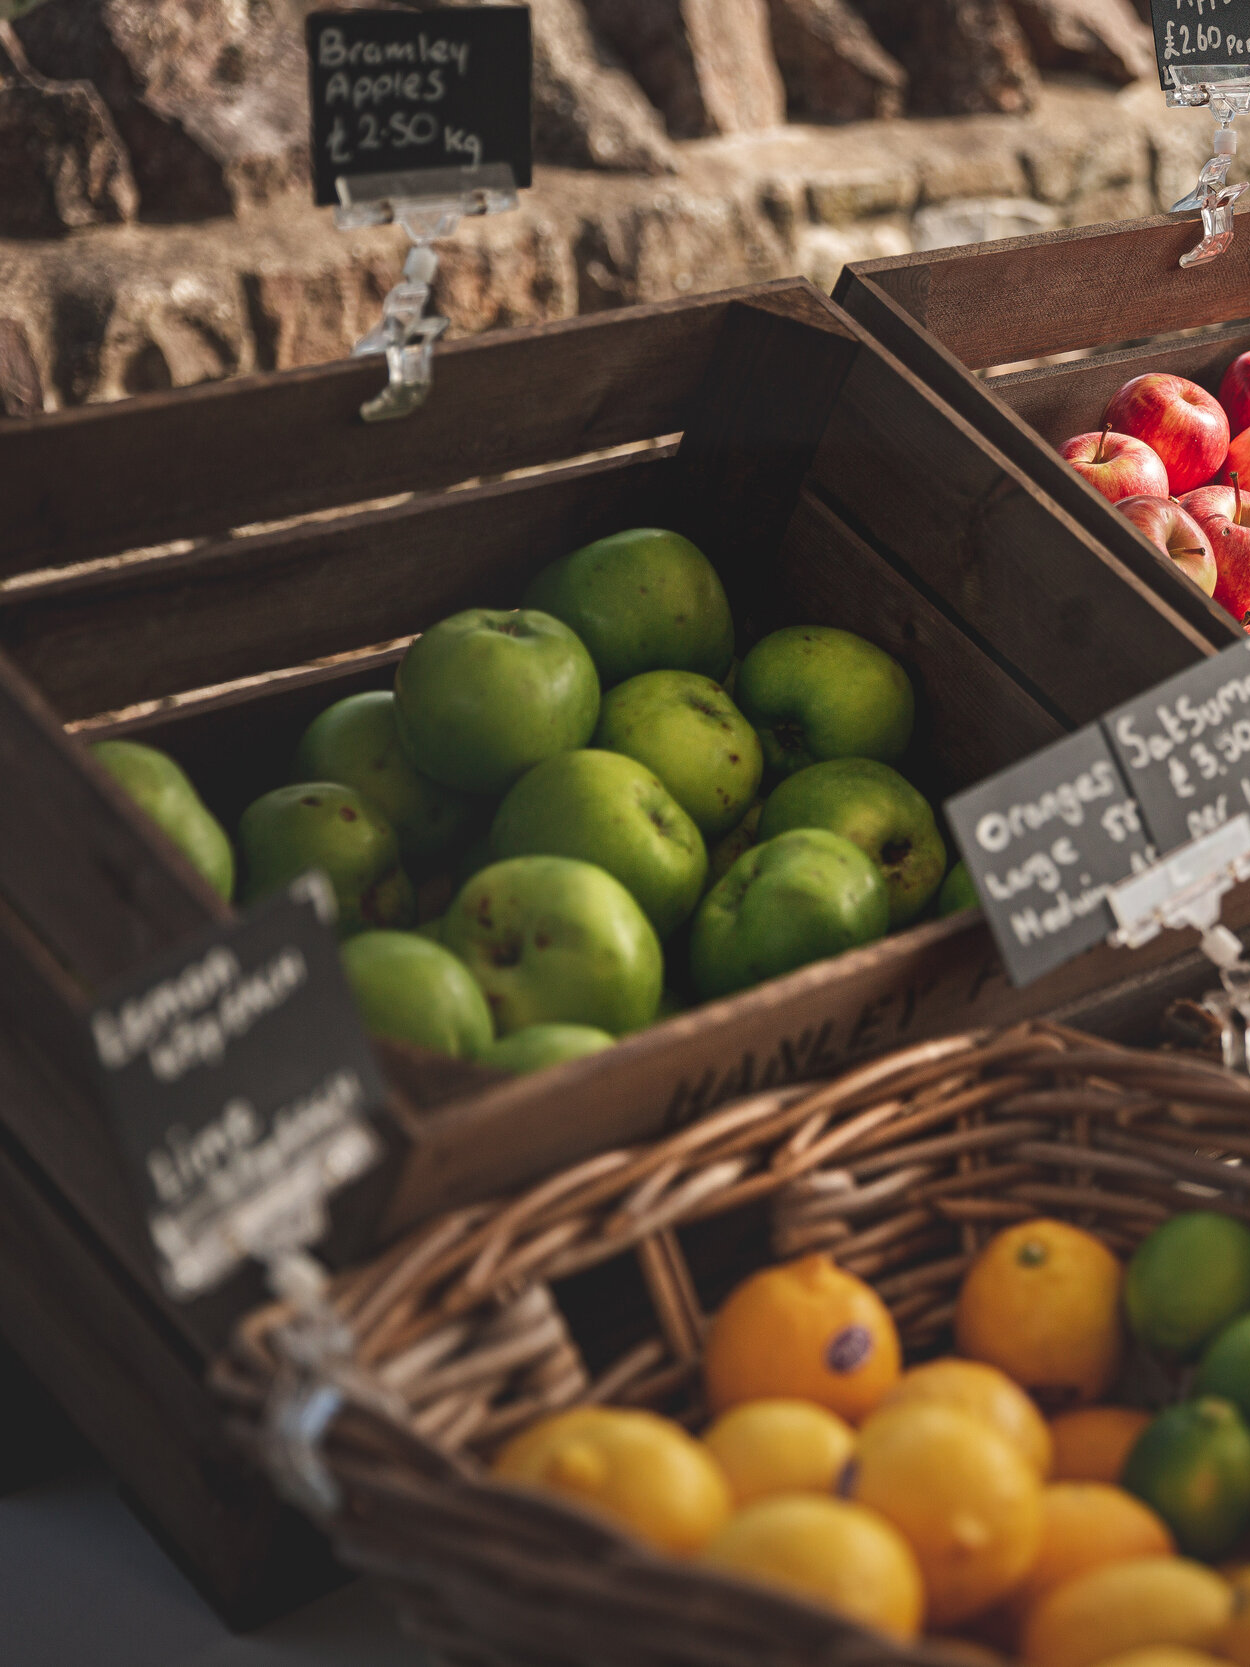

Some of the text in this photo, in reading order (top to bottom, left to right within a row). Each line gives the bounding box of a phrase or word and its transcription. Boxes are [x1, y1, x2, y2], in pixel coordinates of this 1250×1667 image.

[318, 27, 469, 76] Bramley
[1164, 20, 1221, 60] £2.60
[325, 69, 445, 109] Apples
[975, 759, 1114, 853] Oranges
